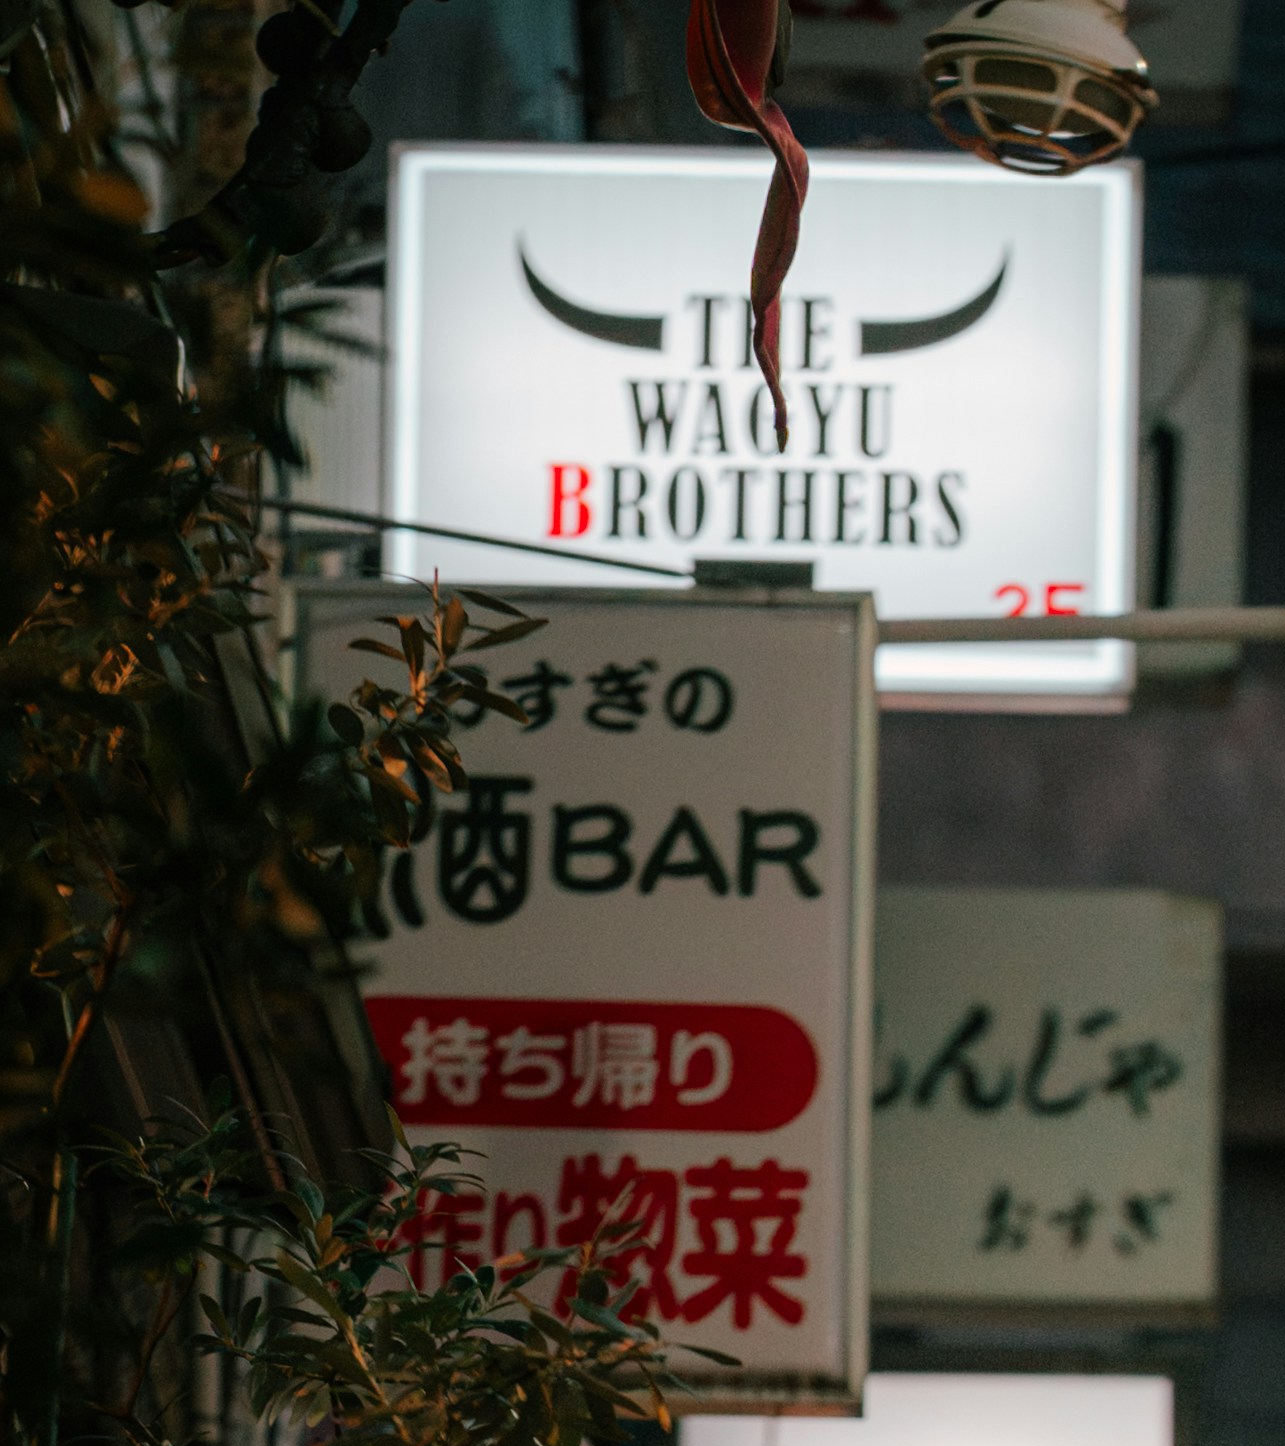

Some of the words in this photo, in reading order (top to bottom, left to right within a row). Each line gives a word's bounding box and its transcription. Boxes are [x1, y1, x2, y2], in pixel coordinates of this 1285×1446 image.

[627, 379, 894, 459] WAGYU
[547, 463, 966, 548] BROTHERS
[402, 1015, 734, 1110] 持ち帰り
